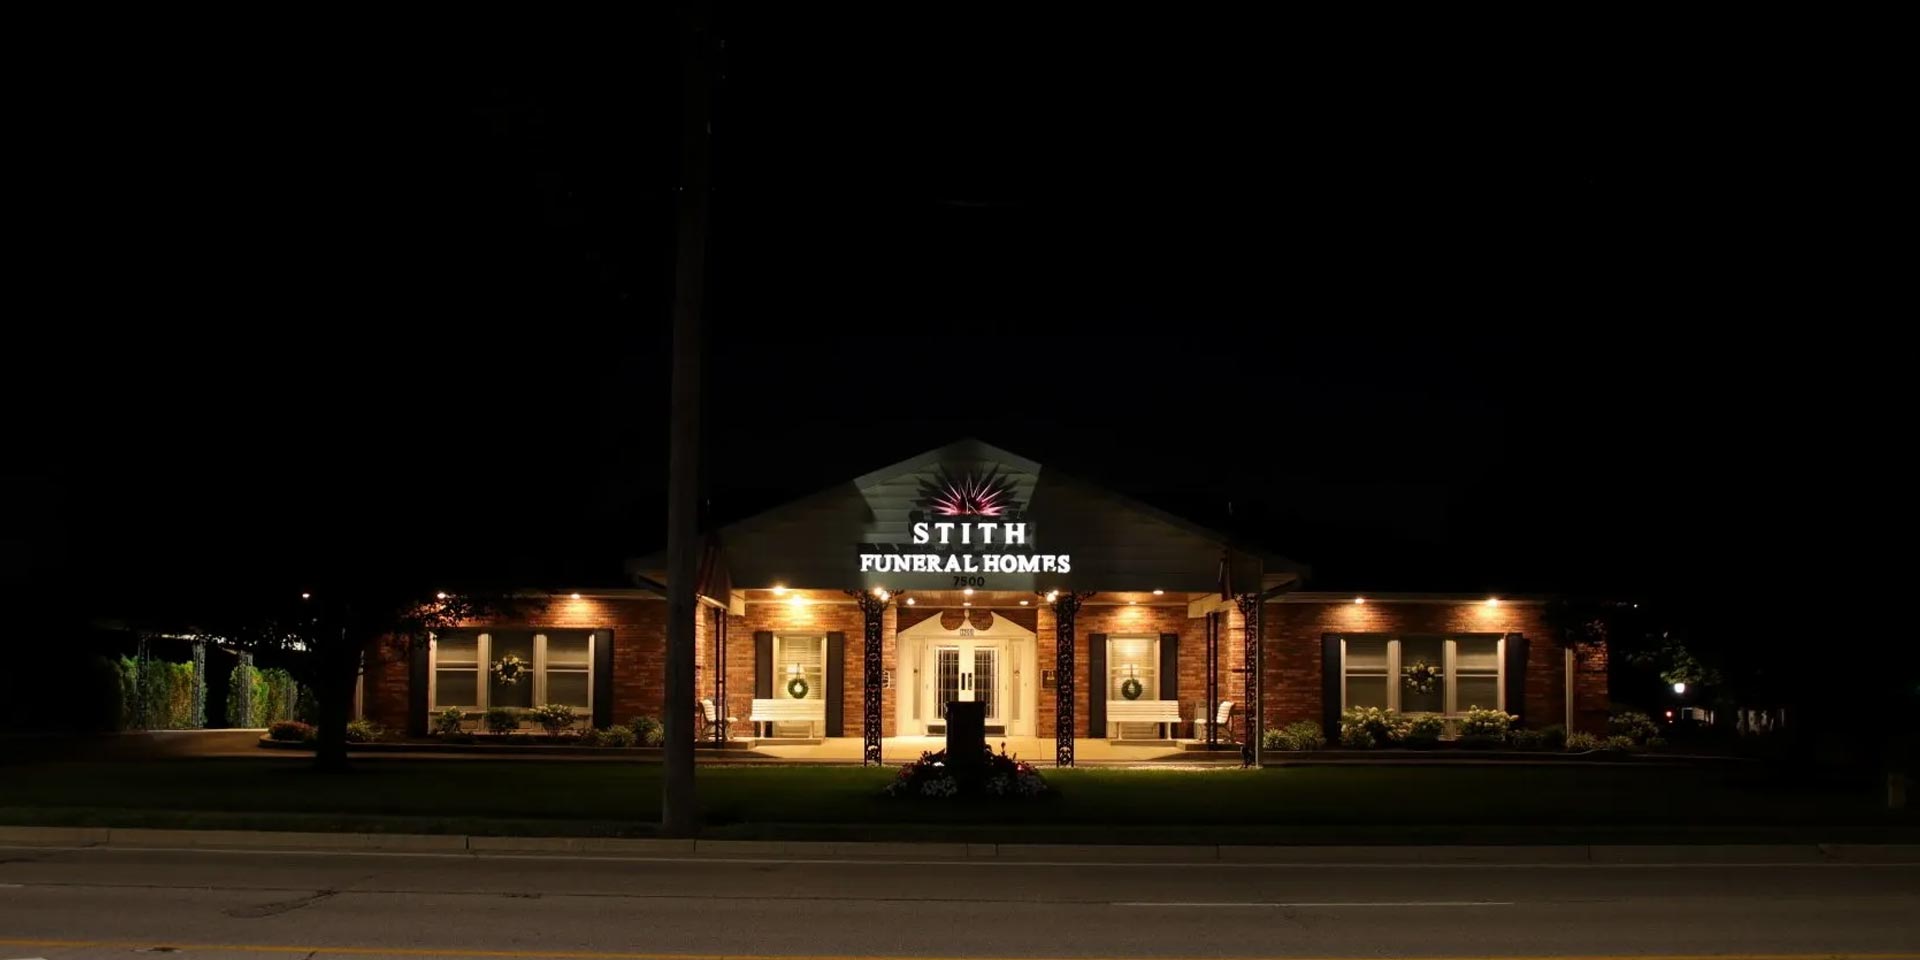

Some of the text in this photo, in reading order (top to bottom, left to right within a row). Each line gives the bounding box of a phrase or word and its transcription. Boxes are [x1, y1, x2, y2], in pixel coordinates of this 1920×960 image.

[913, 522, 1026, 544] STITH
[860, 554, 1071, 573] FUNERAL HOMES
[953, 576, 985, 587] 7500
